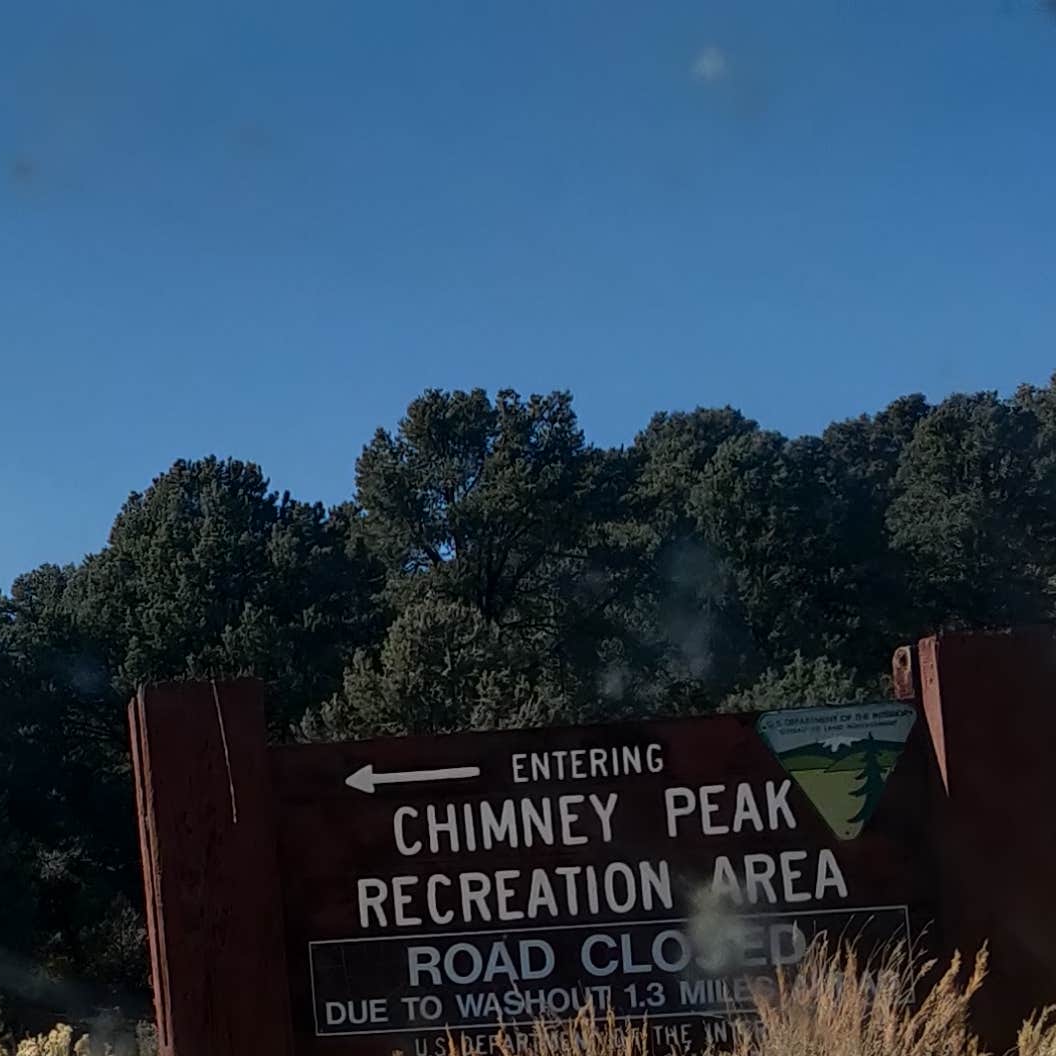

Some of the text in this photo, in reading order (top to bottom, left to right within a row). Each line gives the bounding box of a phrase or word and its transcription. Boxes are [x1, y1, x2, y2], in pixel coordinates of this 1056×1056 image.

[512, 743, 664, 784] ENTERING
[393, 779, 797, 857] CHIMNEY PEAK
[357, 849, 849, 929] RECREATION AREA
[407, 923, 806, 987] ROAD CLOSED
[325, 999, 390, 1026] DUE
[401, 996, 443, 1022] TO
[456, 985, 611, 1019] WASHOUT
[624, 982, 666, 1009] 1.3
[652, 1024, 693, 1050] THE
